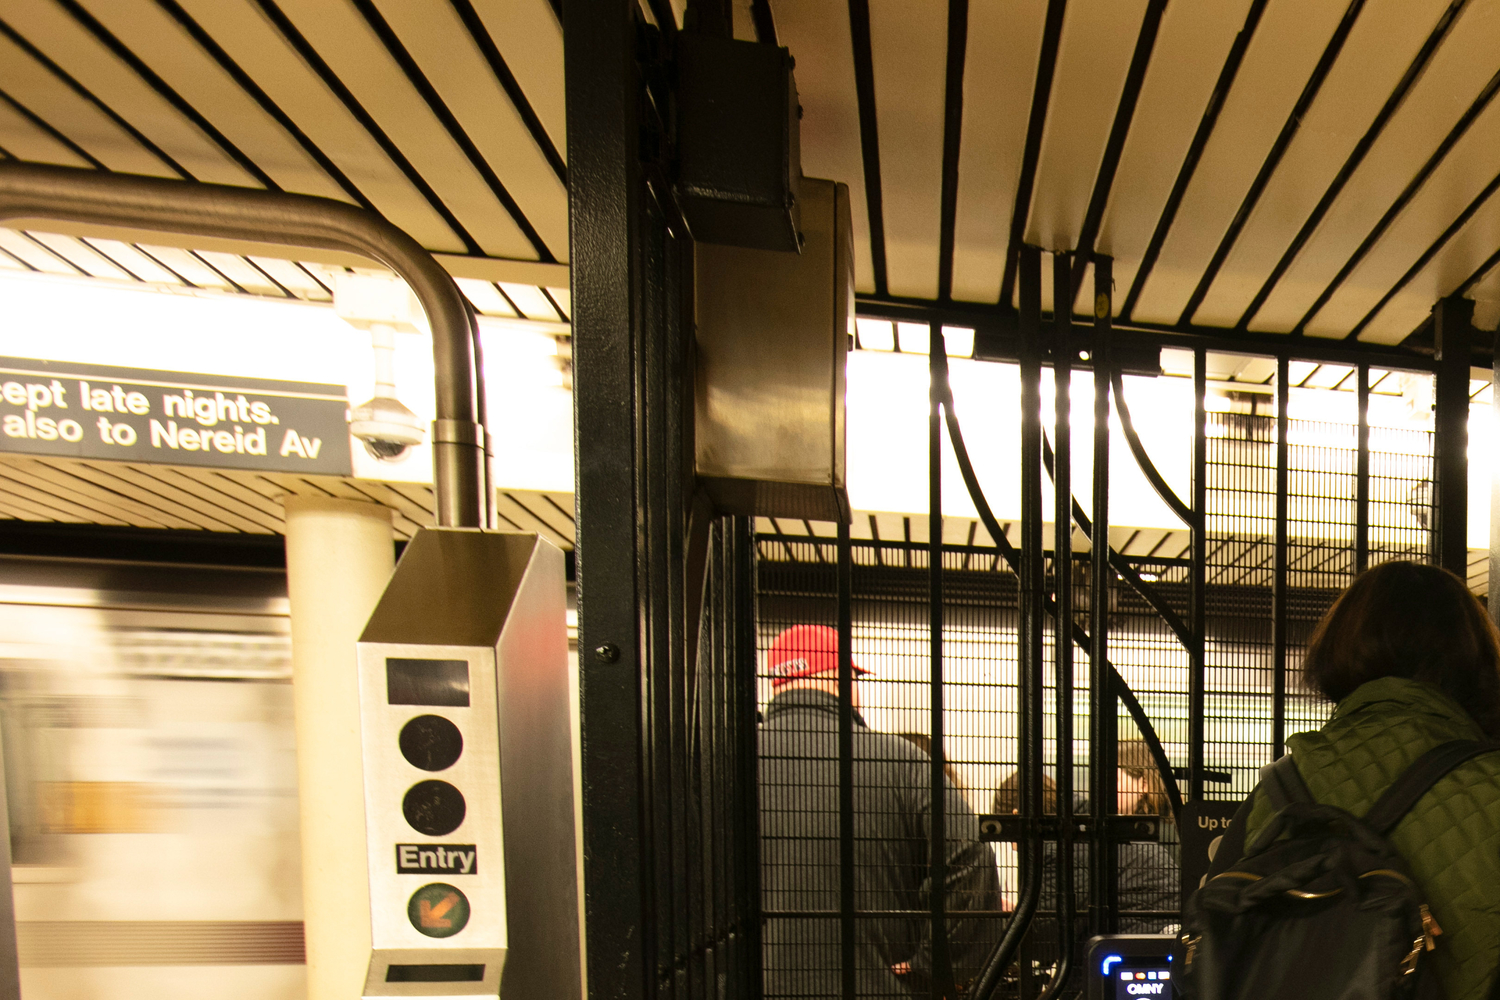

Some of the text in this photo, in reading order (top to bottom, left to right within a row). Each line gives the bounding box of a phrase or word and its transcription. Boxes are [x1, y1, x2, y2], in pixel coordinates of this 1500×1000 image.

[0, 380, 280, 427] ept late nights.
[2, 409, 323, 459] also to Nereid Av
[1197, 815, 1219, 831] Up
[399, 846, 475, 872] Entry
[1127, 983, 1164, 995] OMNY
